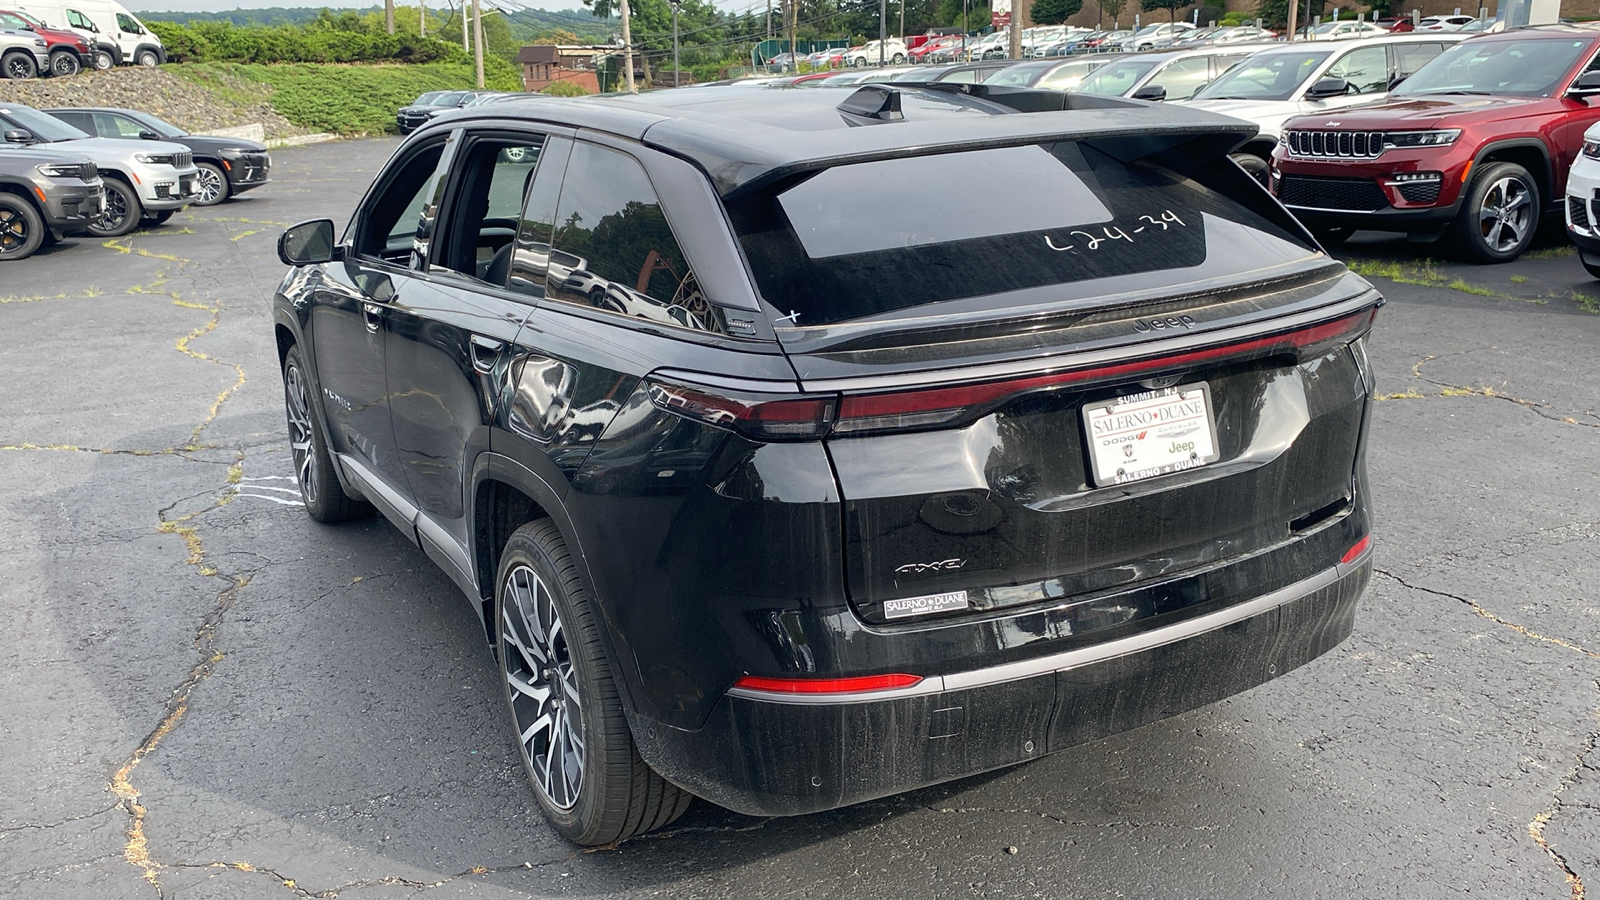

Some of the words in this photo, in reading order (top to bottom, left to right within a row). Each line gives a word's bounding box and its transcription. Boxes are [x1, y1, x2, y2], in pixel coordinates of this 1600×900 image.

[1133, 315, 1196, 333] Jeep
[1117, 390, 1160, 405] SUMMIT,
[1164, 386, 1178, 397] NJ
[1094, 410, 1153, 434] SALERNO
[1159, 400, 1203, 421] DUANE
[1103, 433, 1142, 446] DODGE
[1168, 441, 1195, 454] Jeep
[1114, 467, 1160, 485] SALERNO
[1174, 457, 1206, 471] DUANE
[886, 598, 926, 612] SALERNO
[935, 592, 965, 606] DUANE
